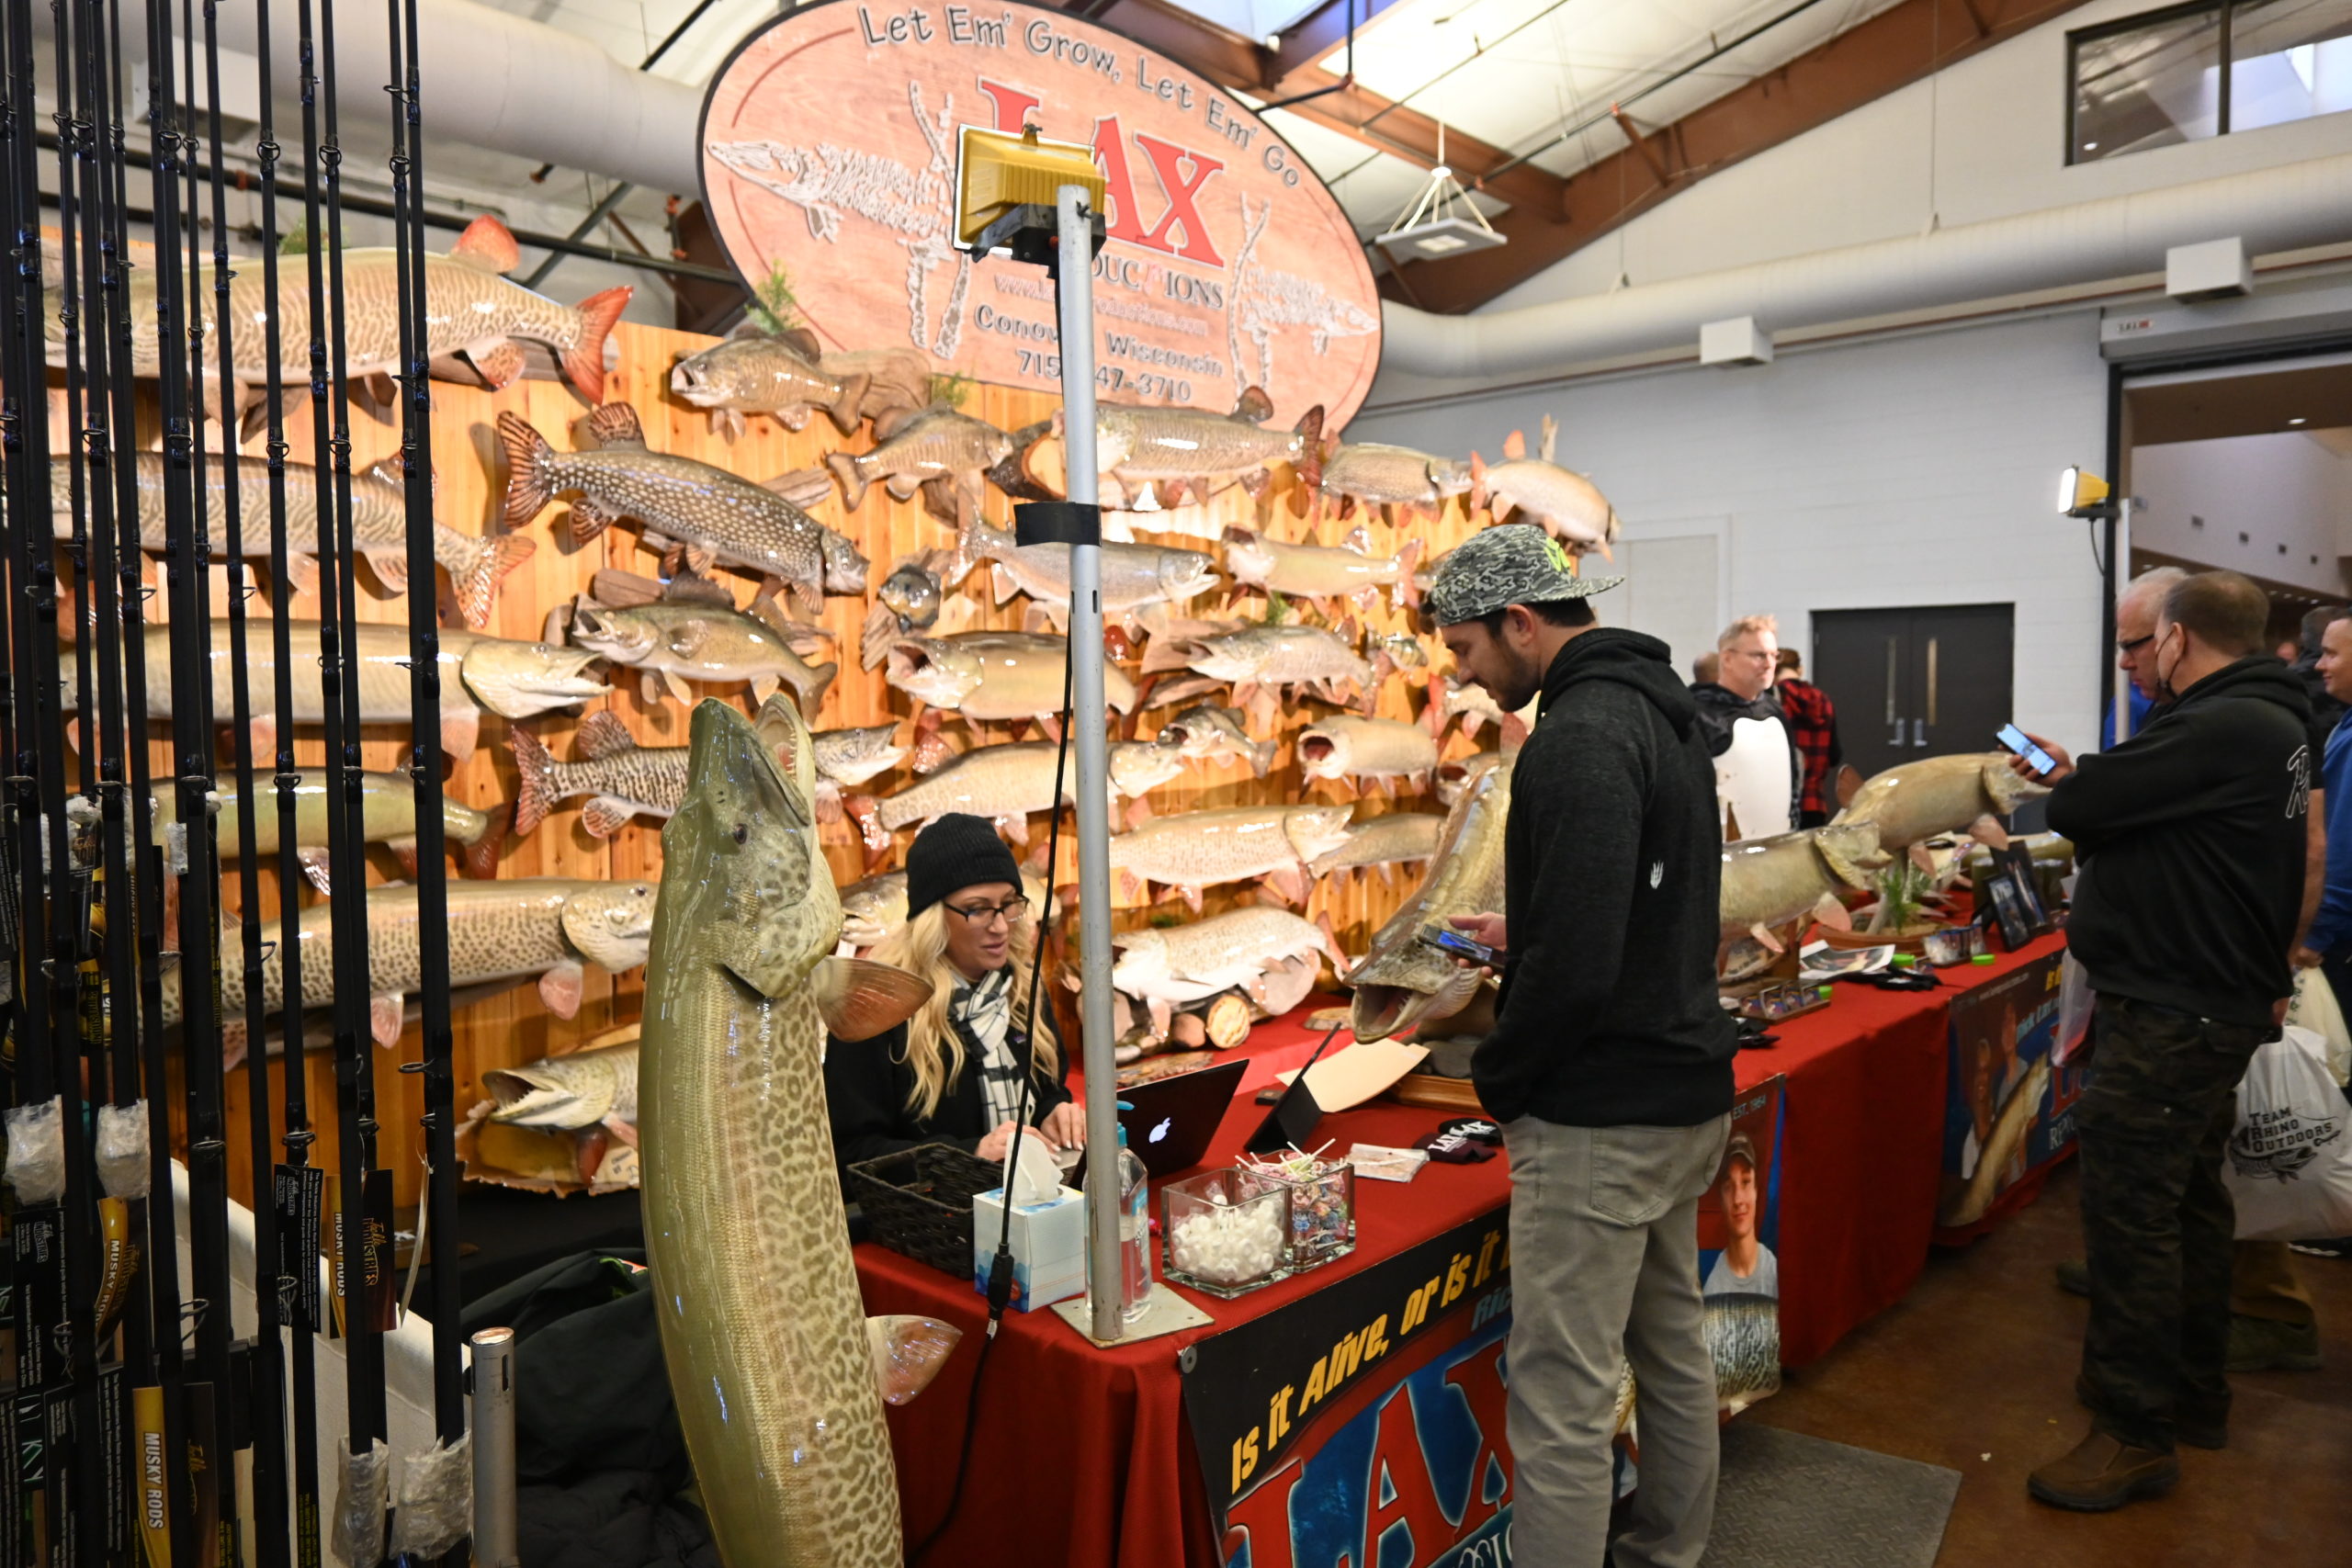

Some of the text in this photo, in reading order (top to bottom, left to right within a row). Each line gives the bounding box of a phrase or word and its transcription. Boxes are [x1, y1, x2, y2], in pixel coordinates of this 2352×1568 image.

[858, 4, 933, 47] Let
[1025, 17, 1122, 82] Grow,
[1136, 54, 1193, 113] Let
[1261, 143, 1302, 189] Go
[1105, 329, 1226, 378] Wisconsin
[2248, 1106, 2292, 1127] TEAM
[2251, 1118, 2300, 1141] RHINO
[2252, 1122, 2333, 1154] OUTDOORS
[106, 1239, 120, 1290] MUSKY
[1267, 1383, 1295, 1451] it
[1297, 1313, 1390, 1418] Alive,
[1399, 1274, 1440, 1337] or
[1440, 1249, 1472, 1307] is
[1472, 1228, 1501, 1289] it
[144, 1432, 164, 1529] MUSKY RODS
